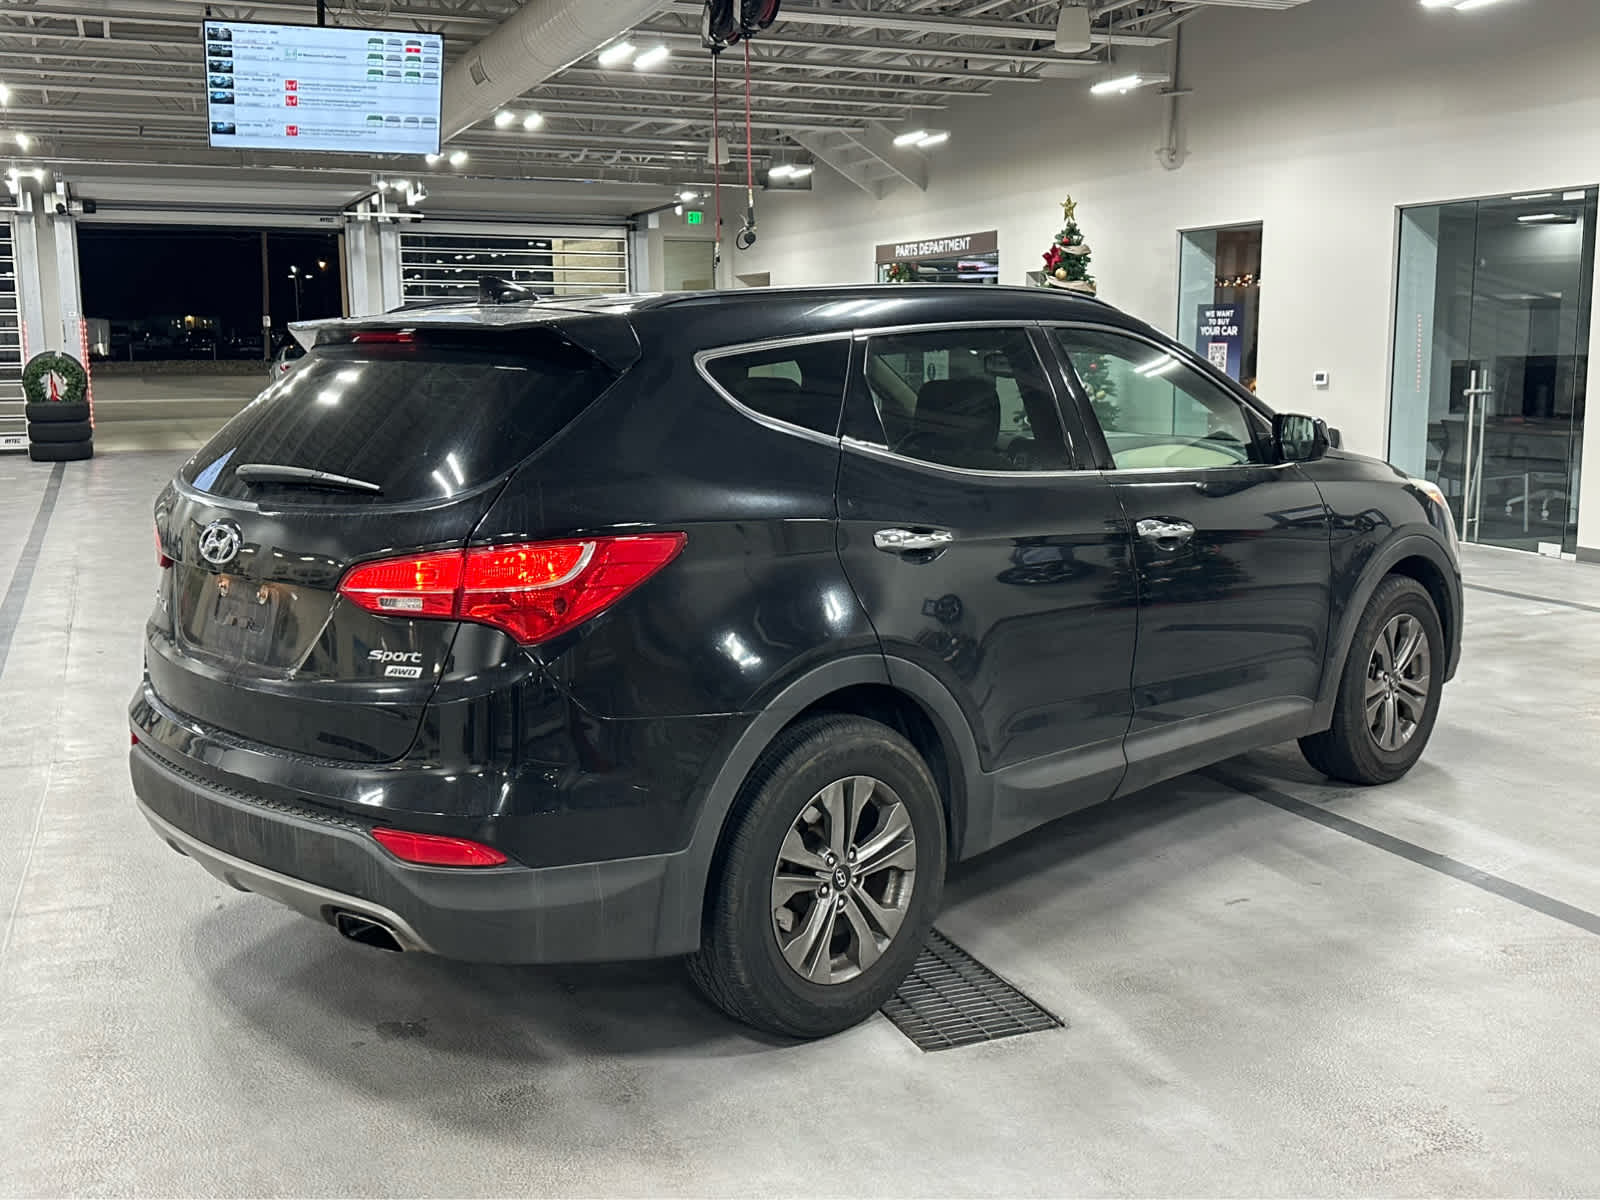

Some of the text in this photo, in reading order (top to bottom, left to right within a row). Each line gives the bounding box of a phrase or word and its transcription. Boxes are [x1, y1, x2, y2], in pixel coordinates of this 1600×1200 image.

[895, 237, 971, 257] PARTS DEPARTMENT
[1200, 326, 1238, 336] YOUR CAR
[367, 649, 422, 663] Sport
[388, 667, 418, 676] AWD
